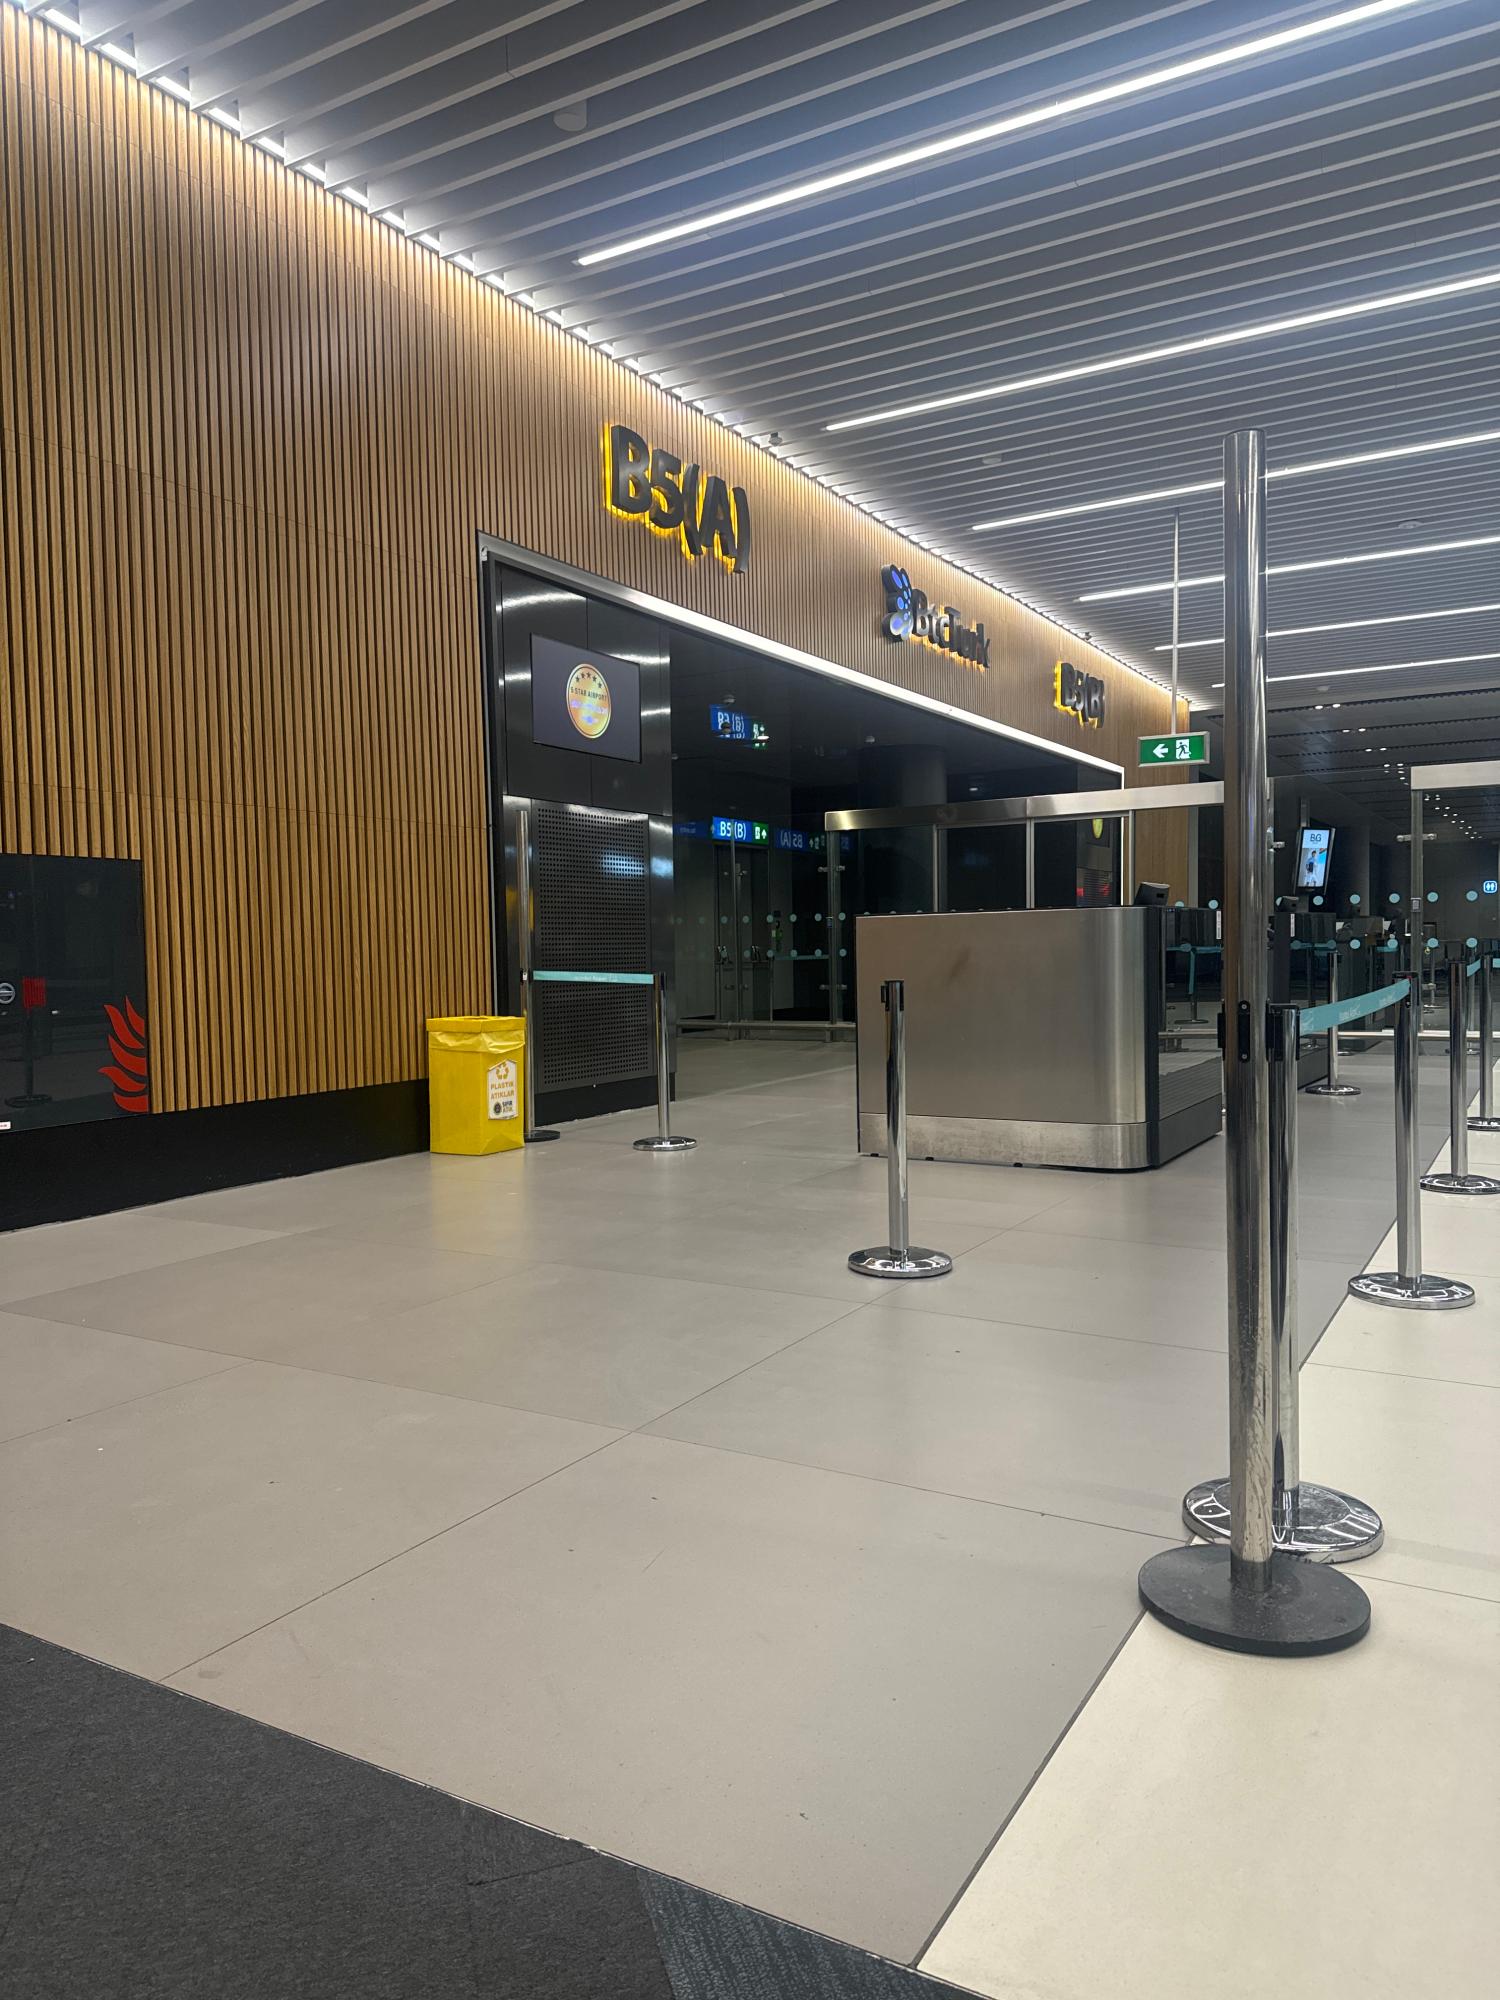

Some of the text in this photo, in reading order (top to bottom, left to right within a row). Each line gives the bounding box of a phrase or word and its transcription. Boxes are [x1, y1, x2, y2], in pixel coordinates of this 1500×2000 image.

[610, 424, 750, 573] B5(A)
[912, 588, 990, 668] BtcTurk
[1060, 662, 1105, 728] B5(B)
[720, 820, 747, 840] B5 (B)
